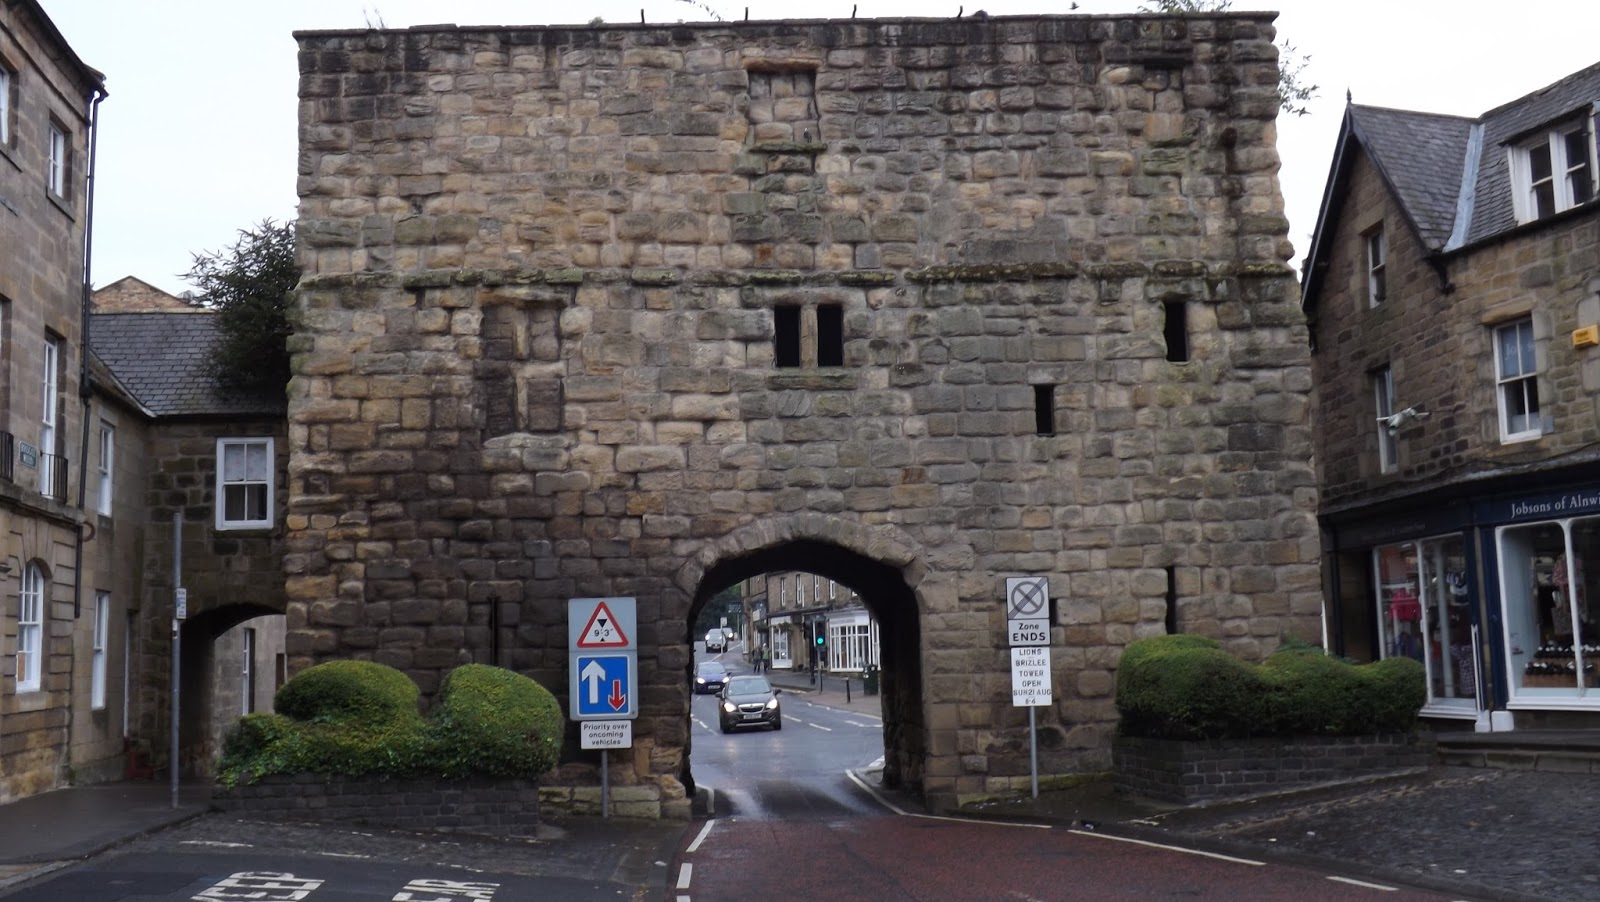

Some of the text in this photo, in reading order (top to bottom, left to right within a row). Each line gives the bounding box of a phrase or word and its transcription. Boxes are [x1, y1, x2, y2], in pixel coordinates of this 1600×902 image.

[1511, 501, 1551, 519] Jobsons
[1554, 496, 1567, 510] of
[1013, 632, 1046, 641] ENDS
[1015, 659, 1047, 667] BRIZLEE
[588, 731, 624, 739] oncoming
